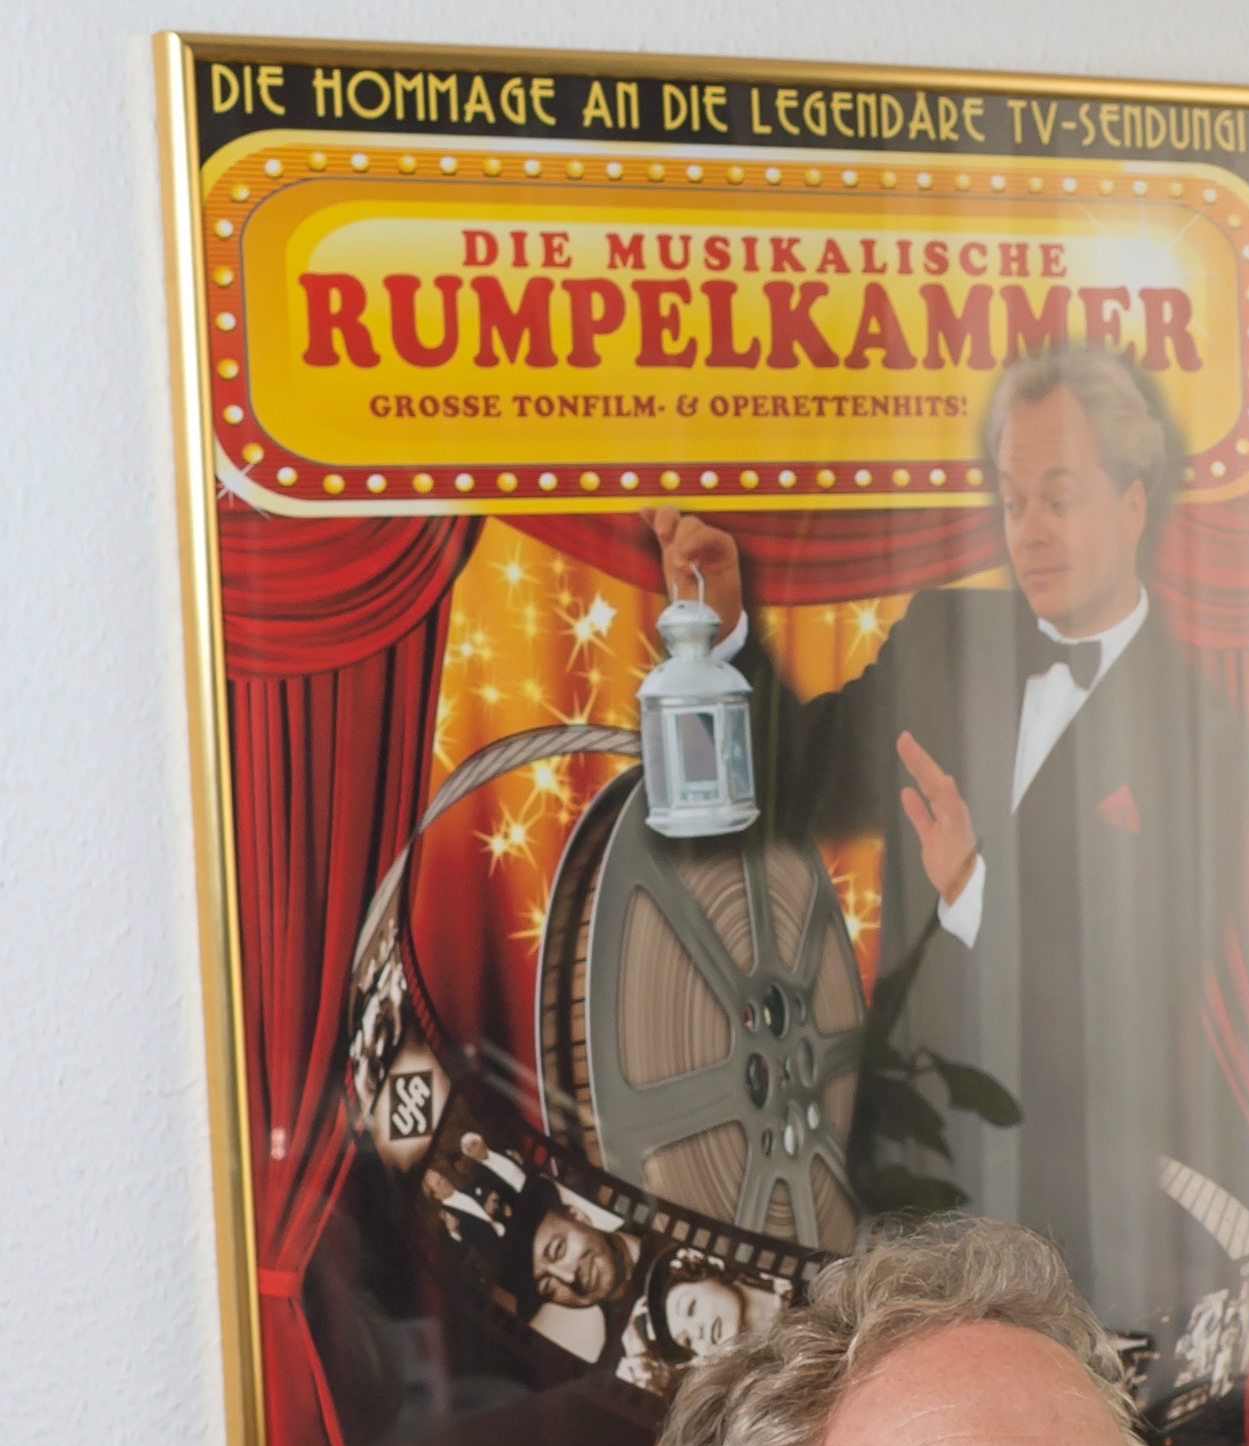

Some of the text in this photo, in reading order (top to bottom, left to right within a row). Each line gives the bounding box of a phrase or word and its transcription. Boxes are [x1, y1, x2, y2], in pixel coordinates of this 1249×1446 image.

[211, 64, 286, 115] DIE
[312, 68, 556, 126] HOMMAGE
[581, 82, 640, 130] AN
[663, 85, 728, 132] DIE
[462, 229, 1067, 278] DIE MUSIKALISCHE
[298, 271, 1204, 372] RUMPELKAMMER
[369, 394, 968, 418] GROSSE TONFILM- & OPERETTENHITS!
